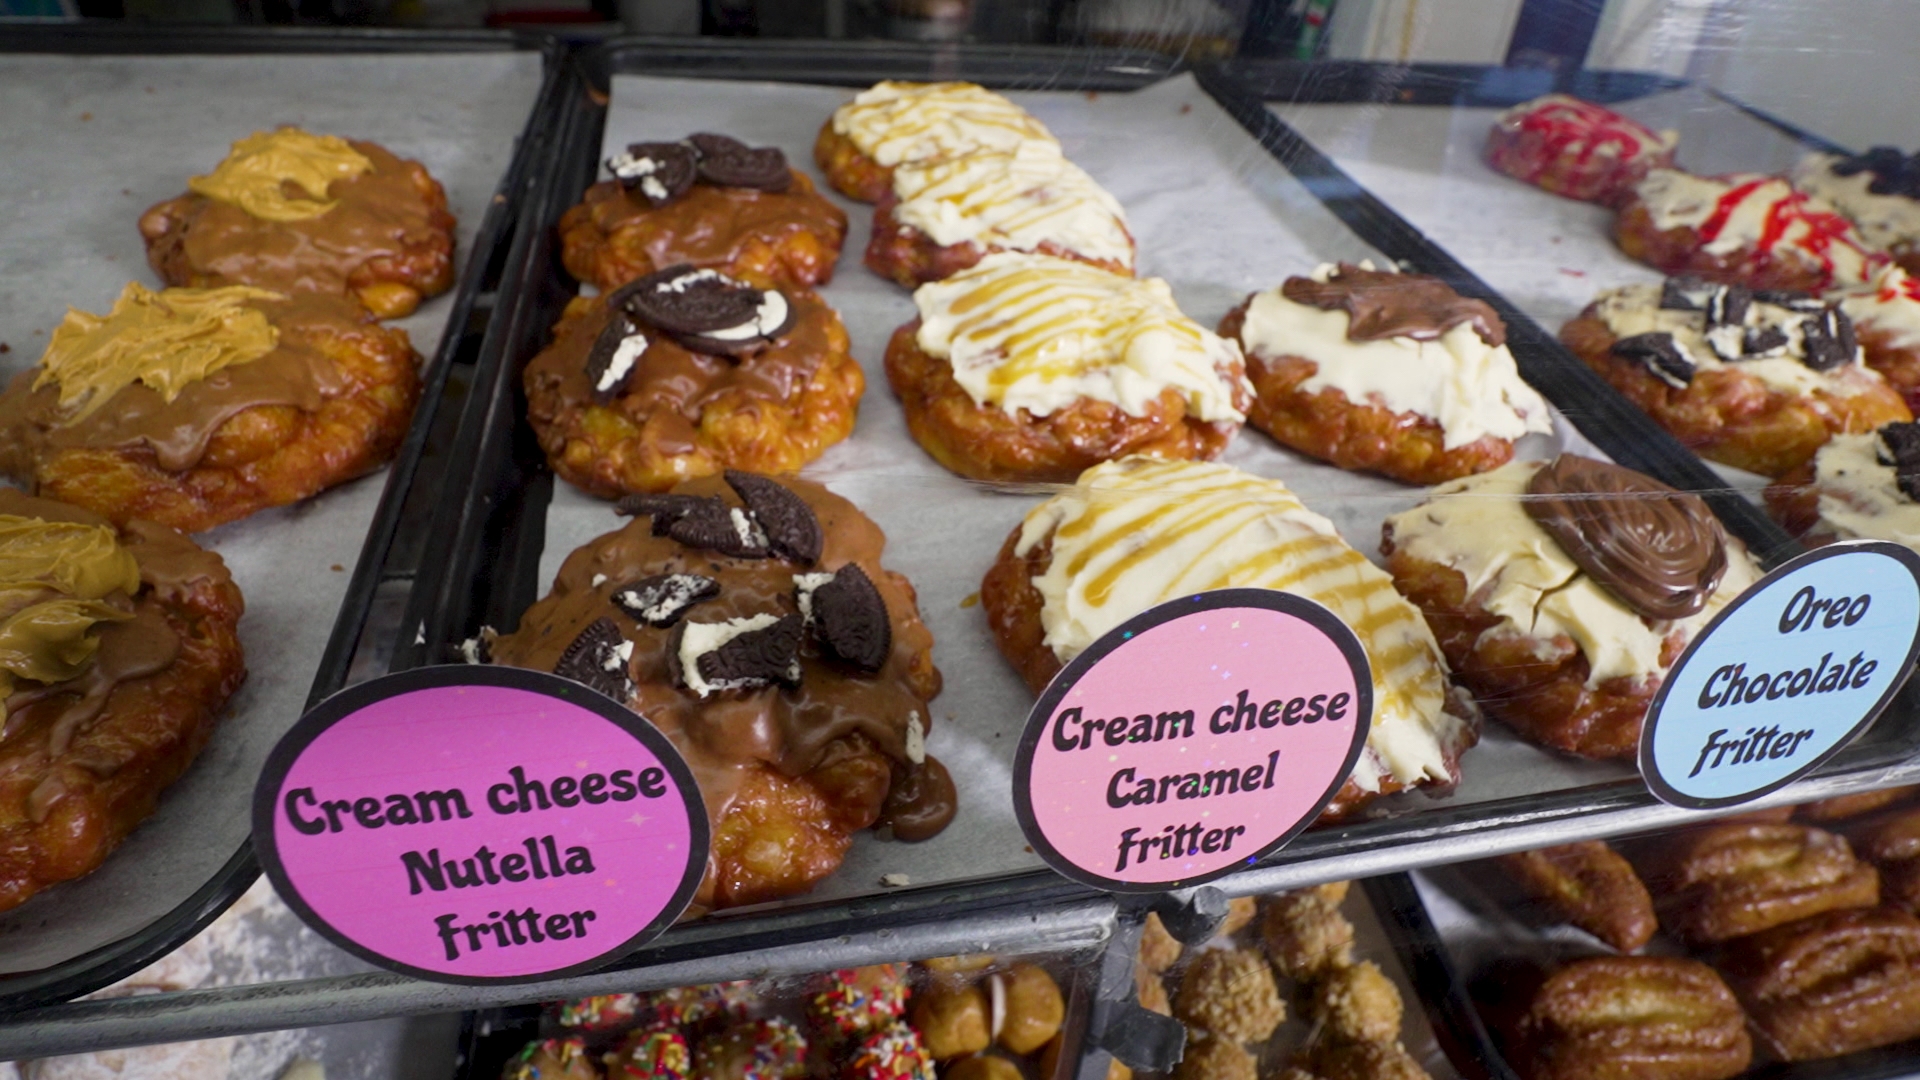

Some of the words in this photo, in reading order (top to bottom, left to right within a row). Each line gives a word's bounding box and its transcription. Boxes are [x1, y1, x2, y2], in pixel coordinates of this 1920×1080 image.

[1778, 585, 1871, 634] Oreo
[1698, 650, 1878, 709] Chocolate
[1052, 706, 1195, 752] Cream
[1209, 689, 1350, 735] cheese
[284, 786, 473, 836] Cream
[487, 765, 667, 815] cheese
[1106, 750, 1281, 809] Caramel
[400, 835, 596, 895] Nutella
